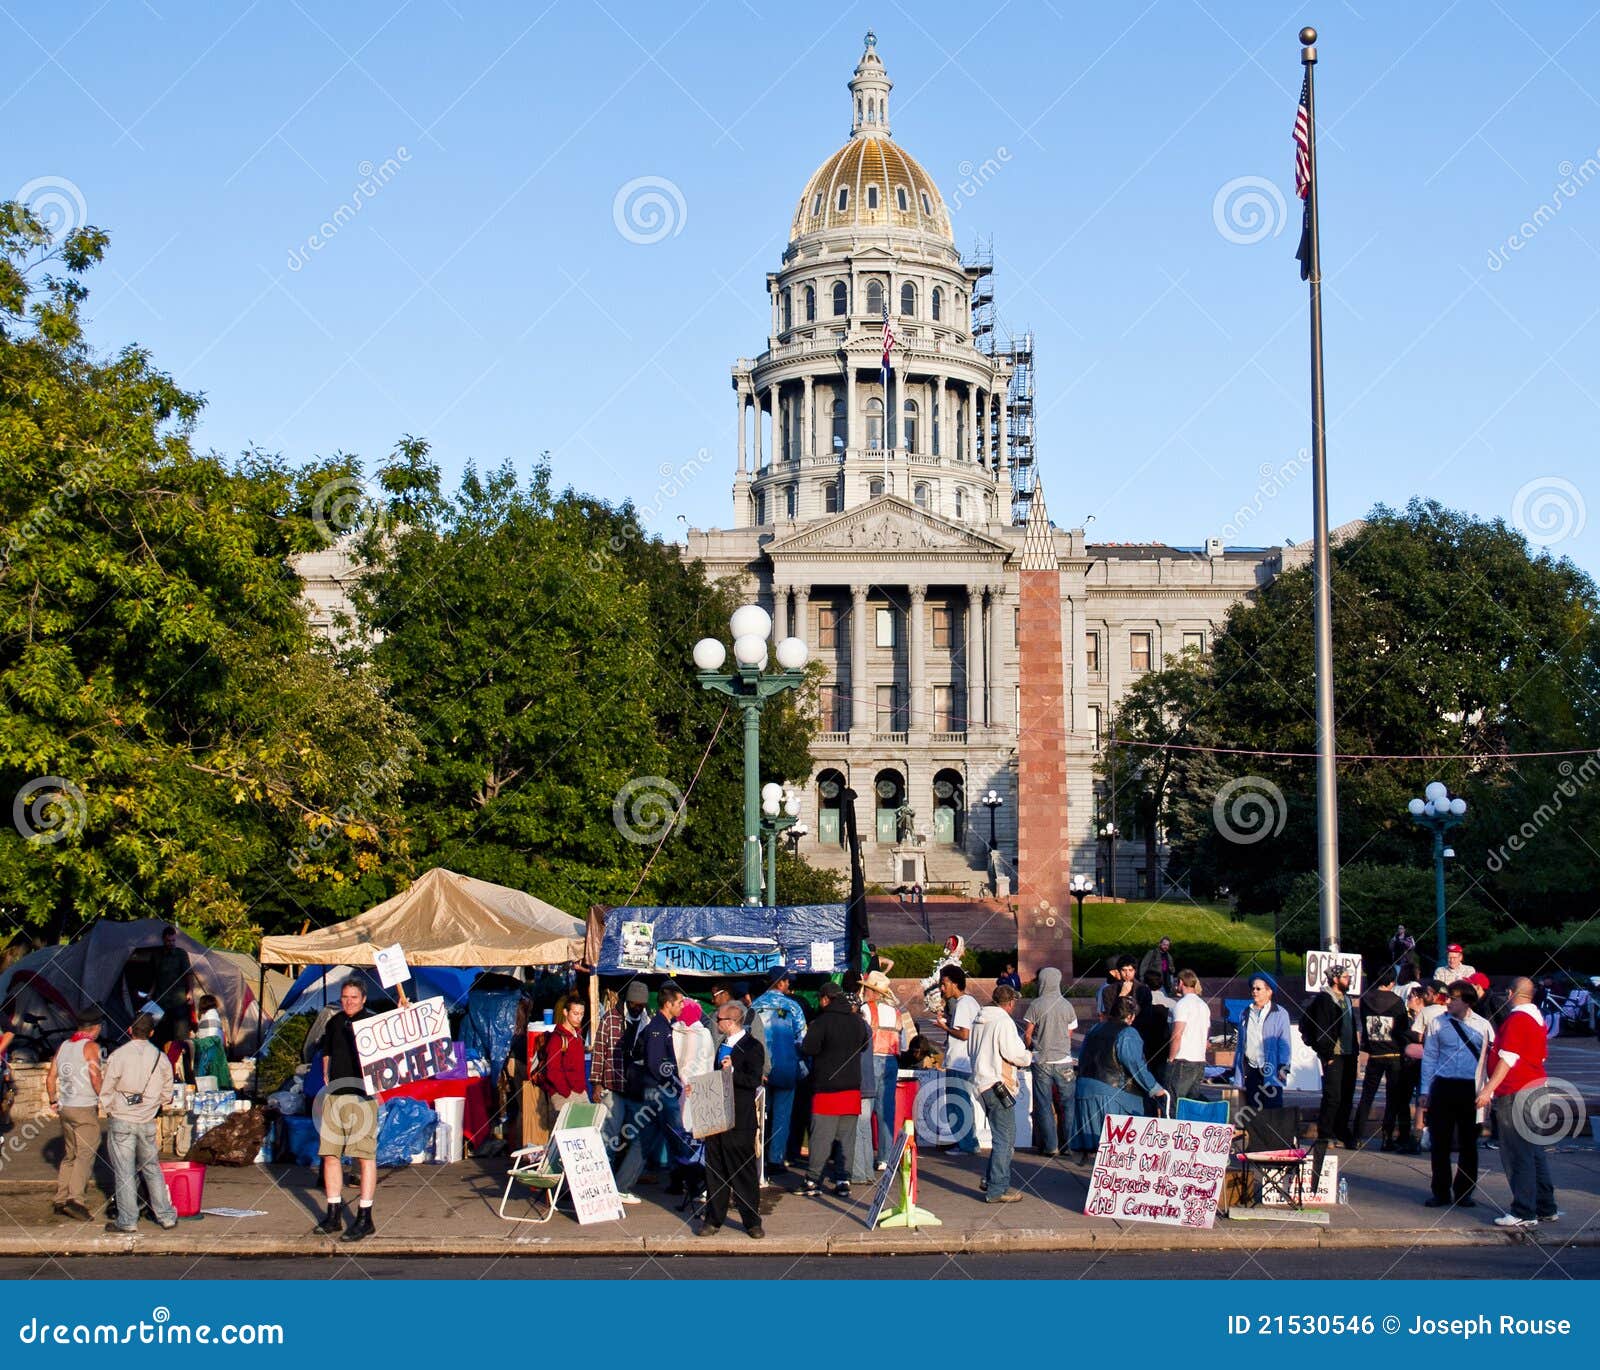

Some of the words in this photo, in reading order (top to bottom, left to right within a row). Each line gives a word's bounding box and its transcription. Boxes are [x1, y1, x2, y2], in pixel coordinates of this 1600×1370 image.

[355, 1002, 447, 1057] OCCUPY
[563, 1138, 588, 1152] THEY
[1106, 1115, 1137, 1145] We
[1140, 1119, 1170, 1149] Are
[1172, 1123, 1201, 1152] the
[1152, 1174, 1178, 1198] the
